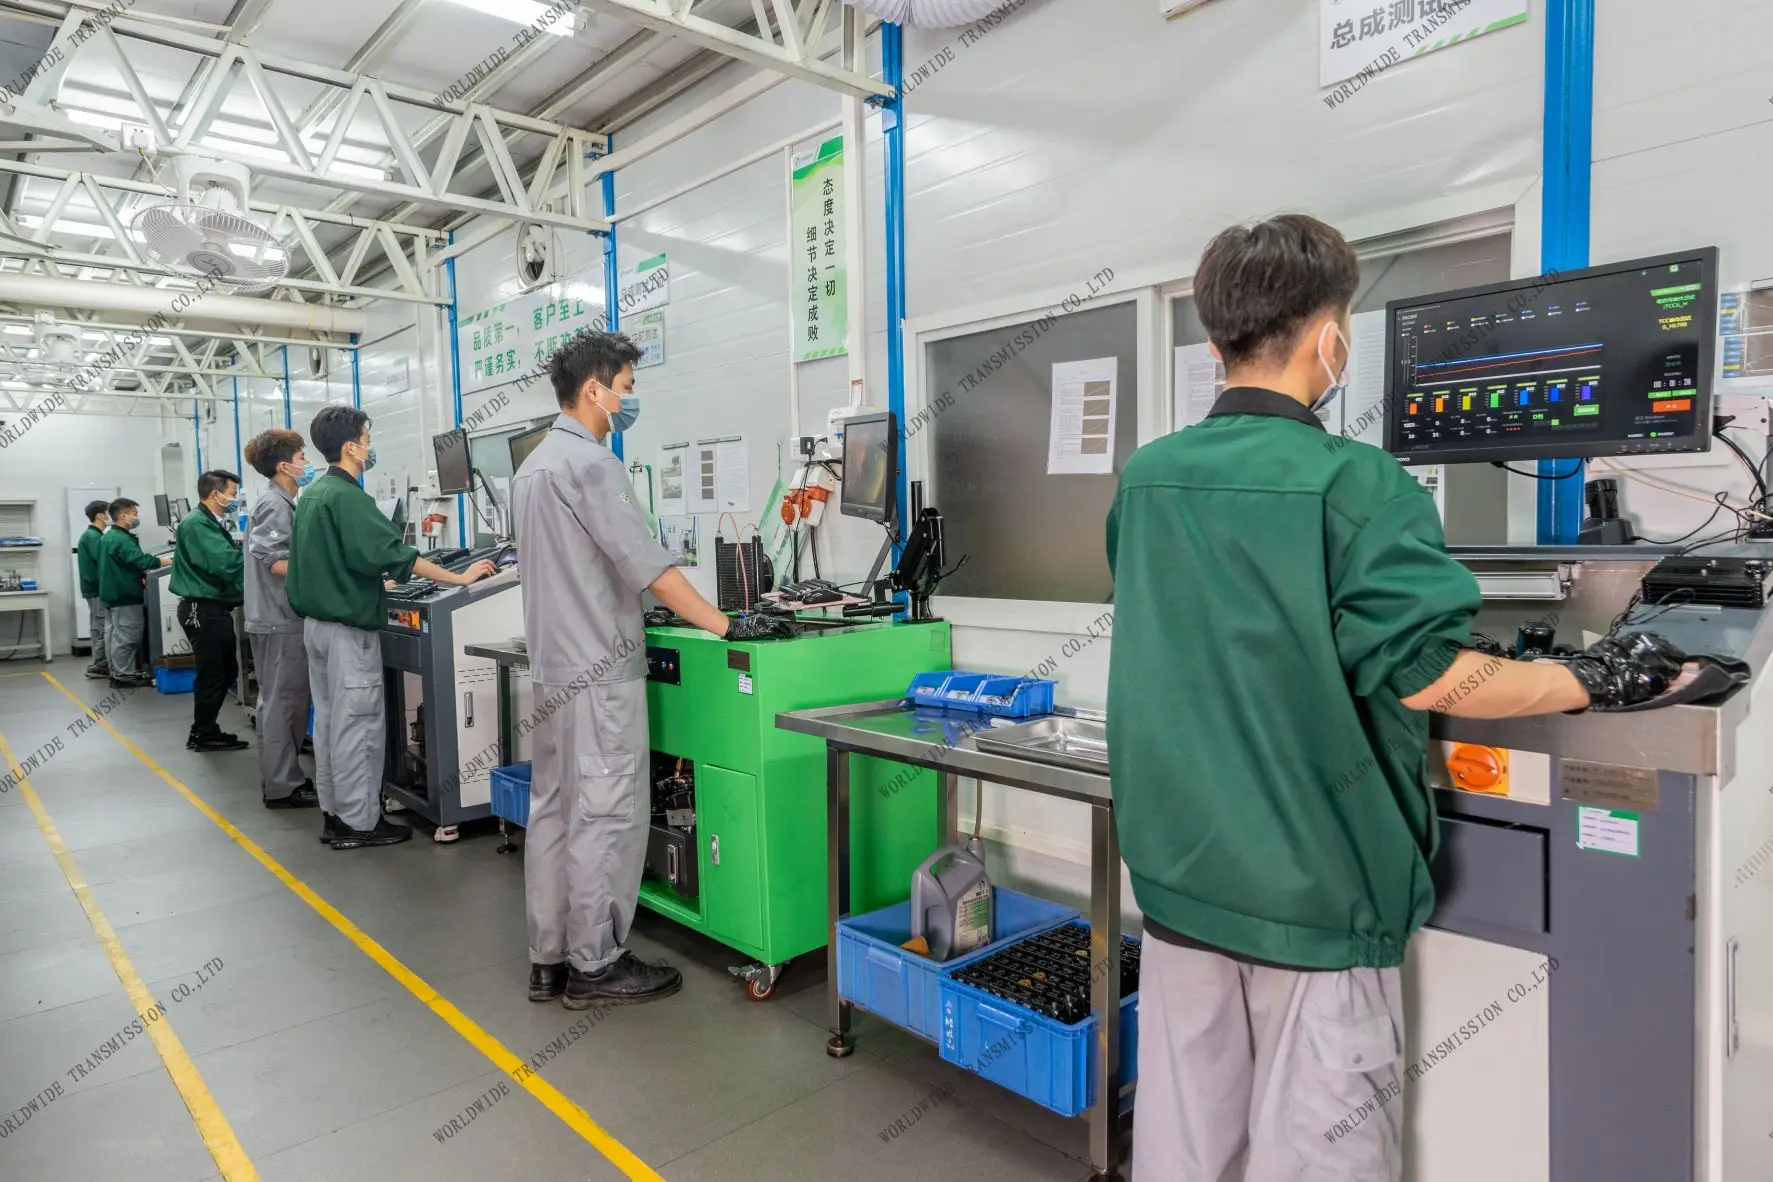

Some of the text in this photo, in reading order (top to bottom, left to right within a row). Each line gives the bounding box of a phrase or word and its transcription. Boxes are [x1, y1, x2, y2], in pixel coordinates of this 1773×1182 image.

[1330, 0, 1471, 49] 总成测试
[823, 177, 836, 297] 态度决定一切
[533, 298, 585, 331] 客户至上
[806, 226, 819, 342] 细节决定成败
